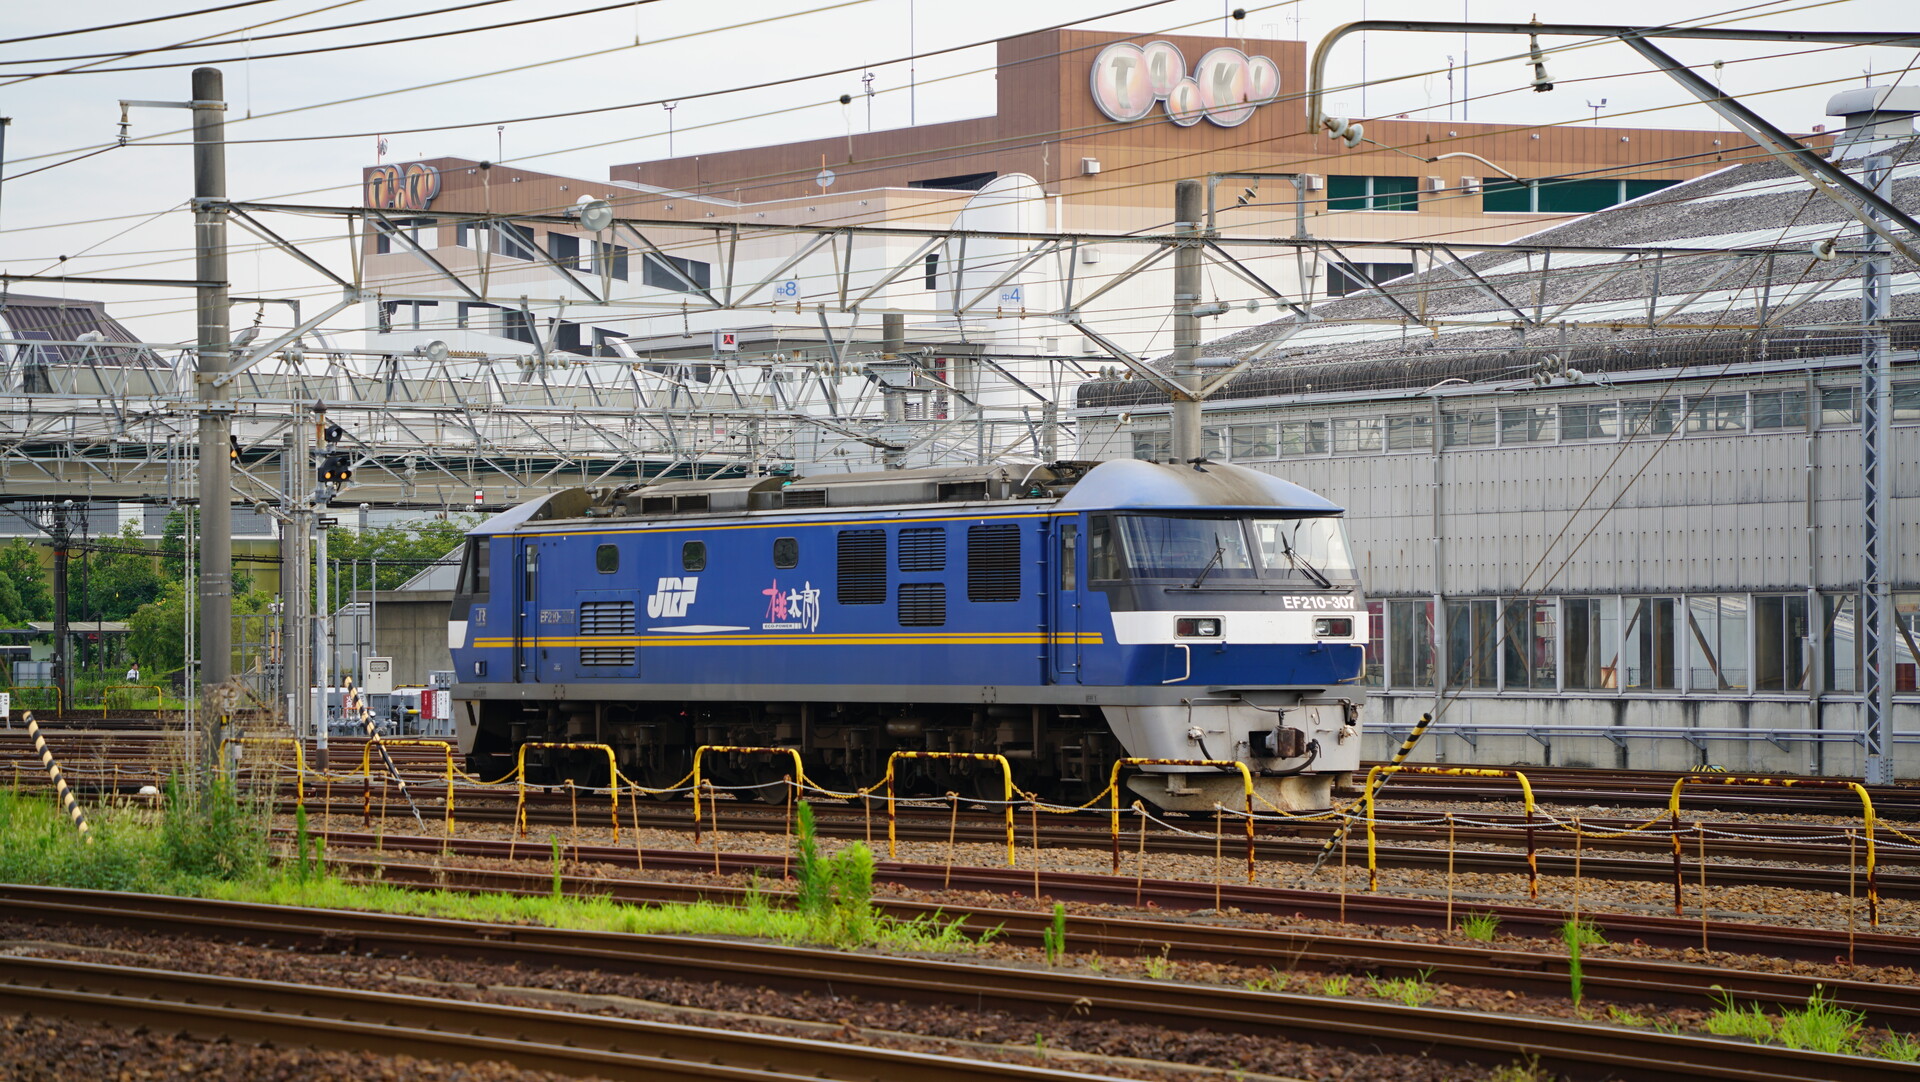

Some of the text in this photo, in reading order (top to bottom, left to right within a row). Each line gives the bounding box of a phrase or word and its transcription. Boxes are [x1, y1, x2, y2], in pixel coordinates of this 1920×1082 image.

[647, 576, 699, 619] JRF
[762, 577, 820, 633] 桃太郎
[1282, 596, 1355, 609] EF210-307
